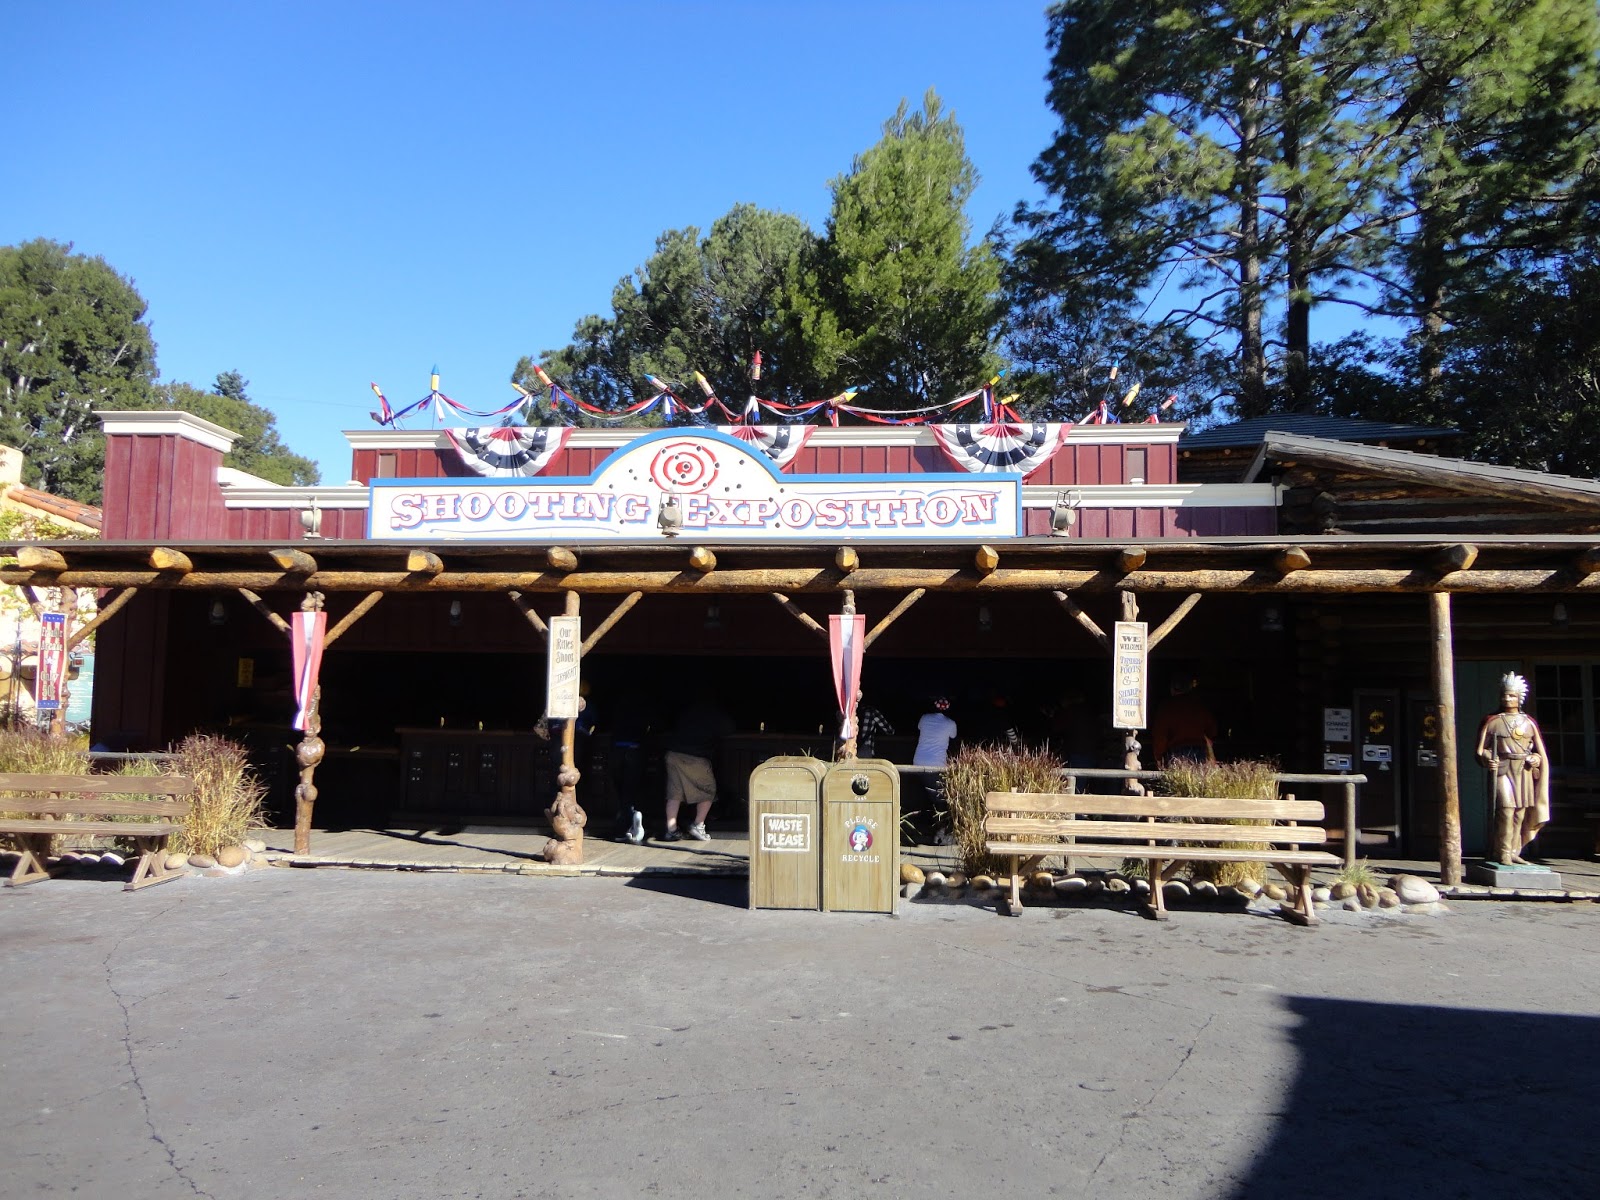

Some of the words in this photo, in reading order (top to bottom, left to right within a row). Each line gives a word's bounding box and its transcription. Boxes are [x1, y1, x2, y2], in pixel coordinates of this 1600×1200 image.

[390, 491, 650, 530] SHOOTING
[672, 493, 997, 530] EXPOSITION
[559, 627, 572, 639] Our
[1122, 635, 1141, 643] WE
[1119, 643, 1143, 651] WELCOME
[768, 818, 803, 832] WASTE
[844, 815, 879, 829] PLEASE
[766, 833, 805, 847] PLEASE
[842, 854, 880, 863] RECYCLE
